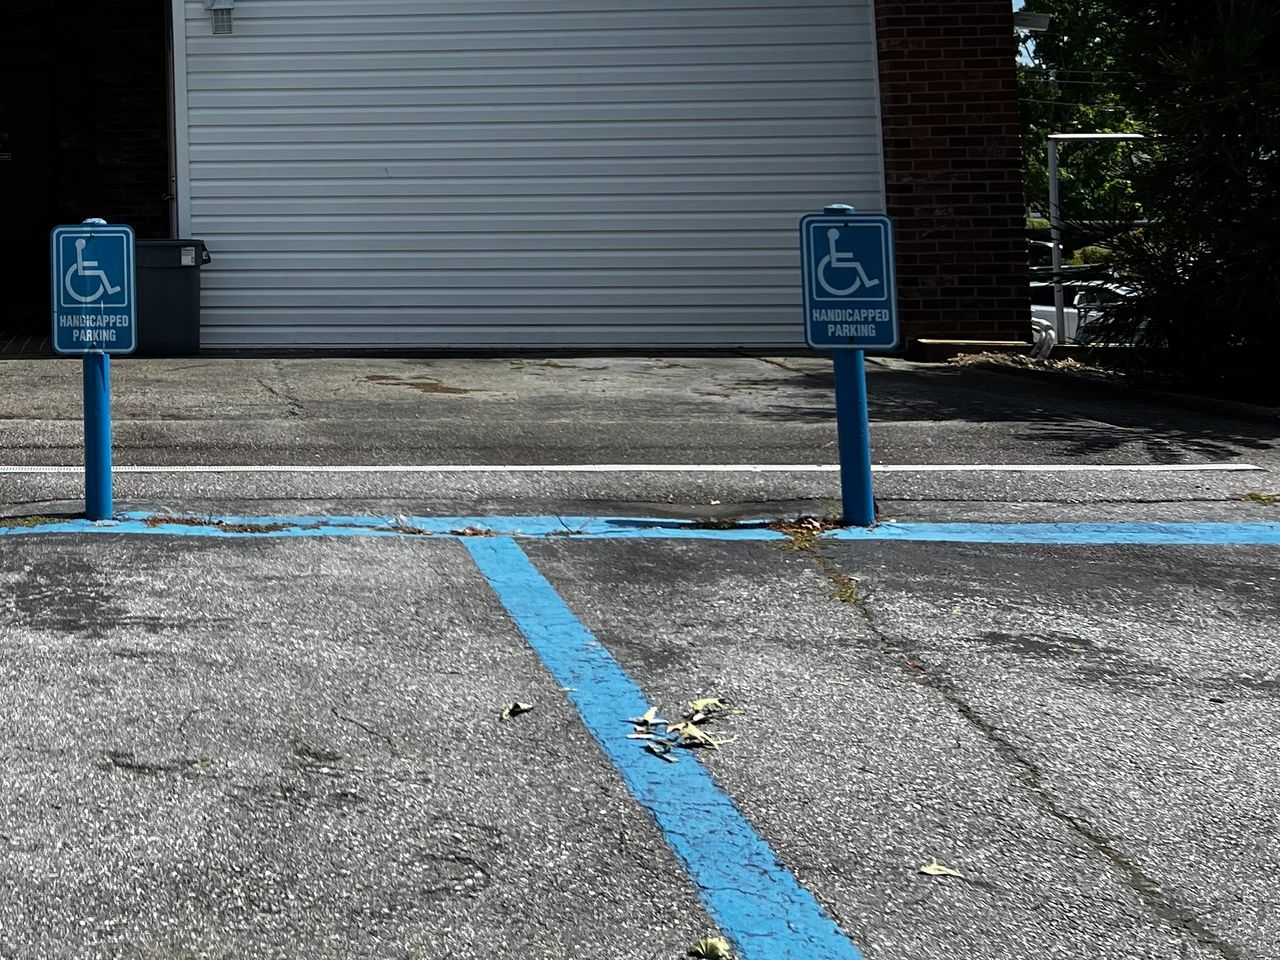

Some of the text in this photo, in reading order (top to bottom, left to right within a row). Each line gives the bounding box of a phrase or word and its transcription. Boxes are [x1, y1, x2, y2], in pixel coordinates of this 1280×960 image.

[60, 315, 129, 327] HANDICAPPED
[812, 309, 889, 321] HANDICAPPED
[73, 329, 117, 341] PARKING
[828, 324, 876, 337] PARKING
